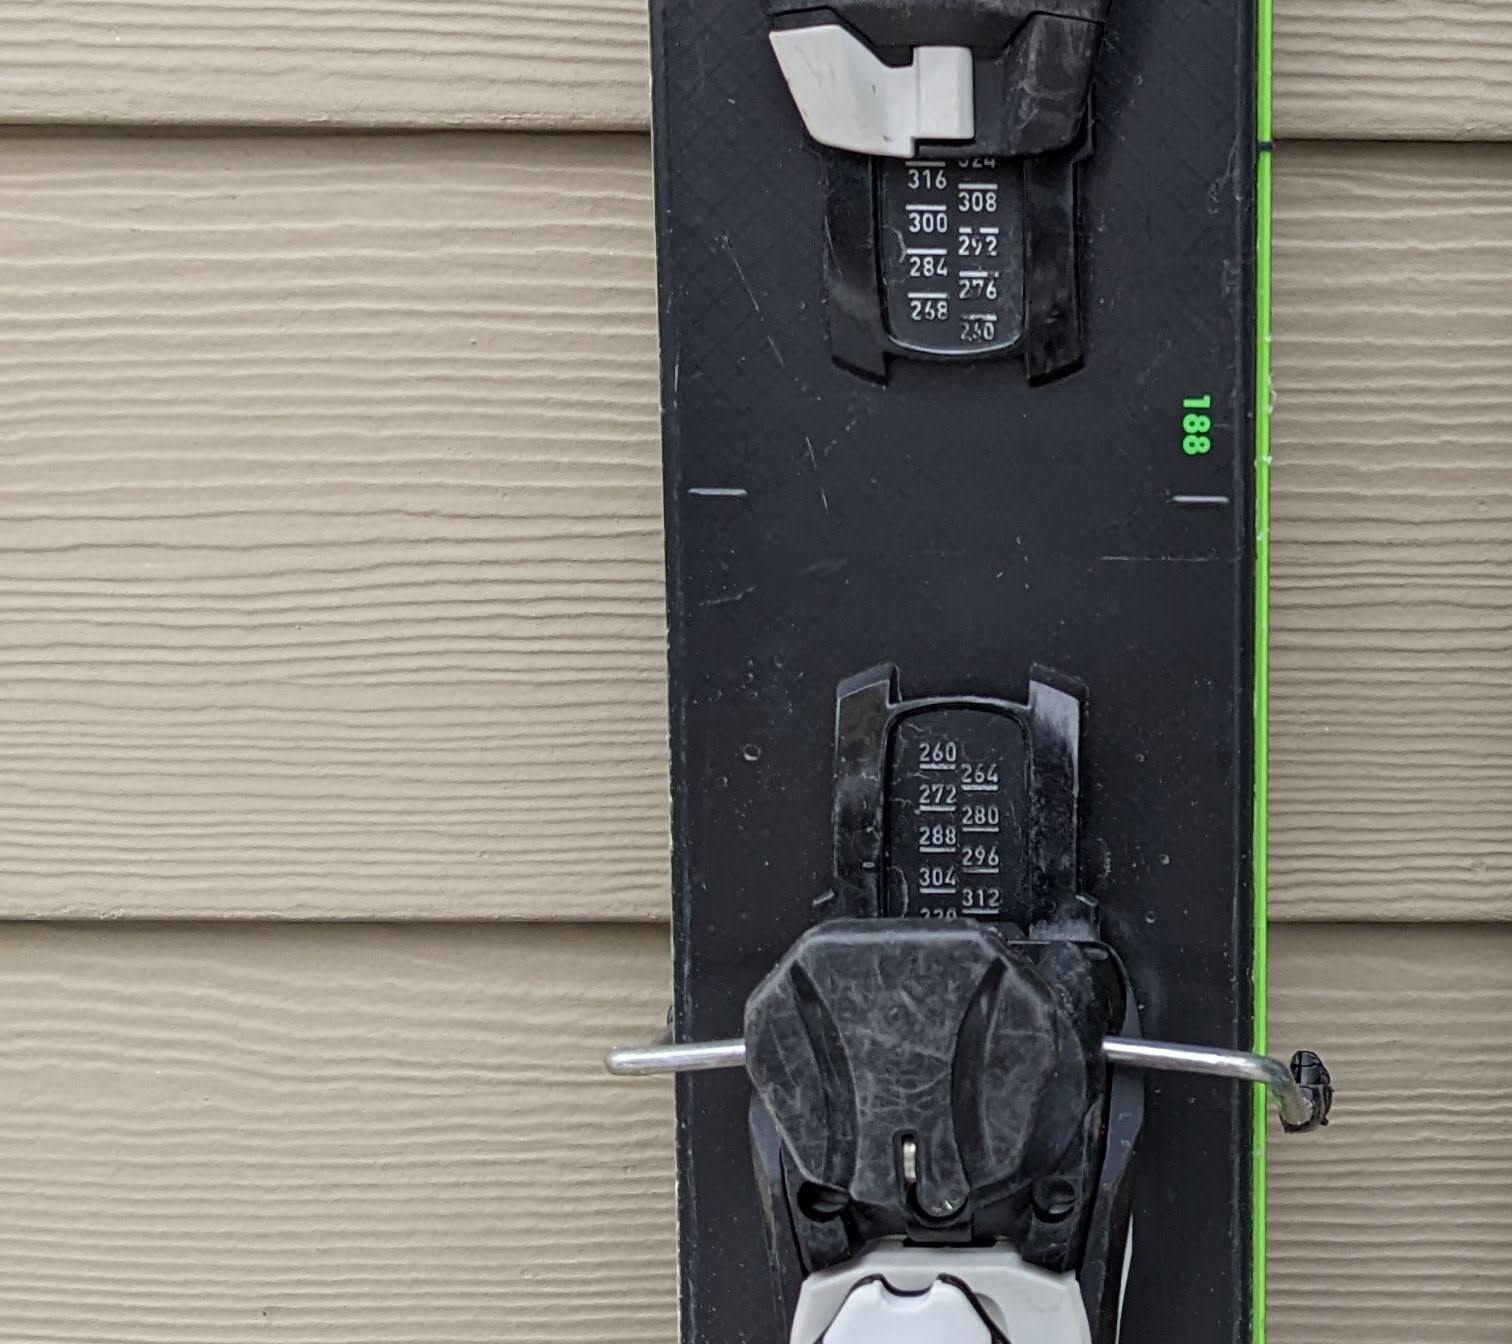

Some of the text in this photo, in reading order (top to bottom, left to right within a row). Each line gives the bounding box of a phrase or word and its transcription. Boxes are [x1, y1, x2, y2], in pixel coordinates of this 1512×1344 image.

[907, 169, 947, 189] 316
[958, 192, 997, 212] 308
[908, 213, 948, 233] 300
[909, 257, 948, 277] 284
[958, 280, 998, 300] 276
[910, 301, 949, 321] 268
[1182, 394, 1211, 455] 188
[919, 742, 957, 762] 260
[961, 763, 999, 783] 264
[919, 784, 957, 804] 272
[961, 807, 999, 825] 280
[919, 825, 957, 845] 288
[962, 846, 1000, 866] 296
[919, 867, 957, 886] 304
[962, 888, 1001, 907] 312
